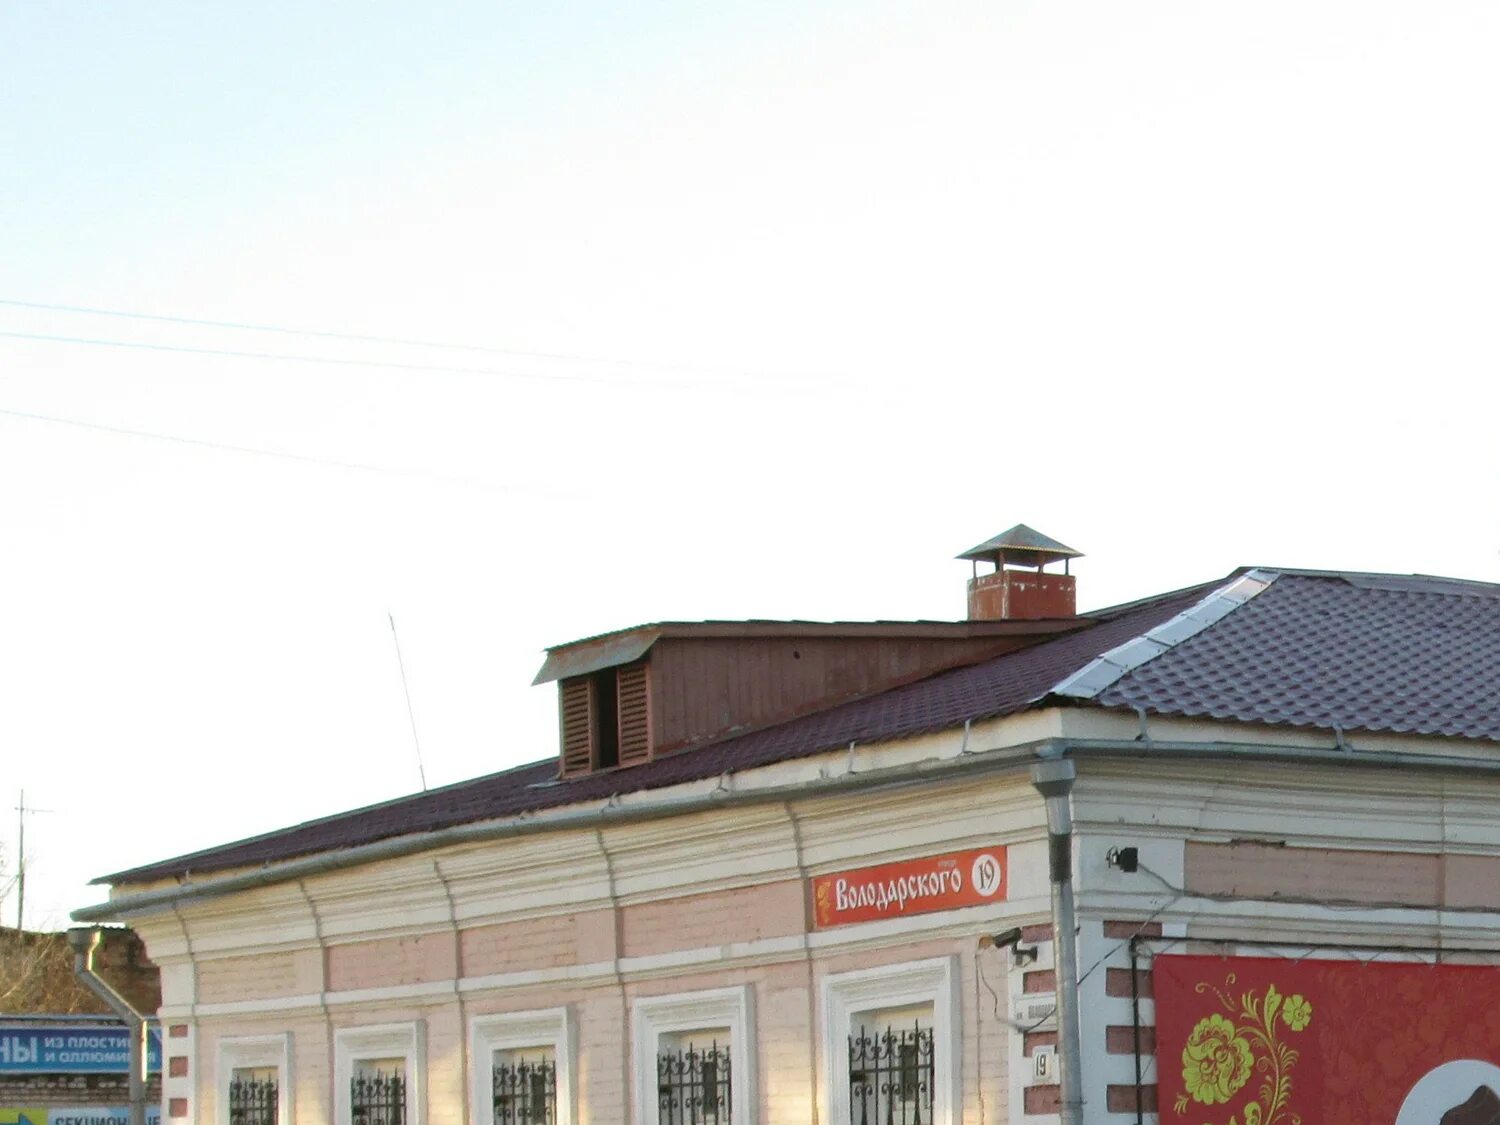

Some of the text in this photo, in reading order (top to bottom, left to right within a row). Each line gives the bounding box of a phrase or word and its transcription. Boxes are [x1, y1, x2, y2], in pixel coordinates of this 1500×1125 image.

[835, 859, 995, 912] Володарского 19
[67, 1037, 131, 1049] пласти
[58, 1050, 156, 1063] аллюмия
[1035, 1054, 1047, 1076] 19
